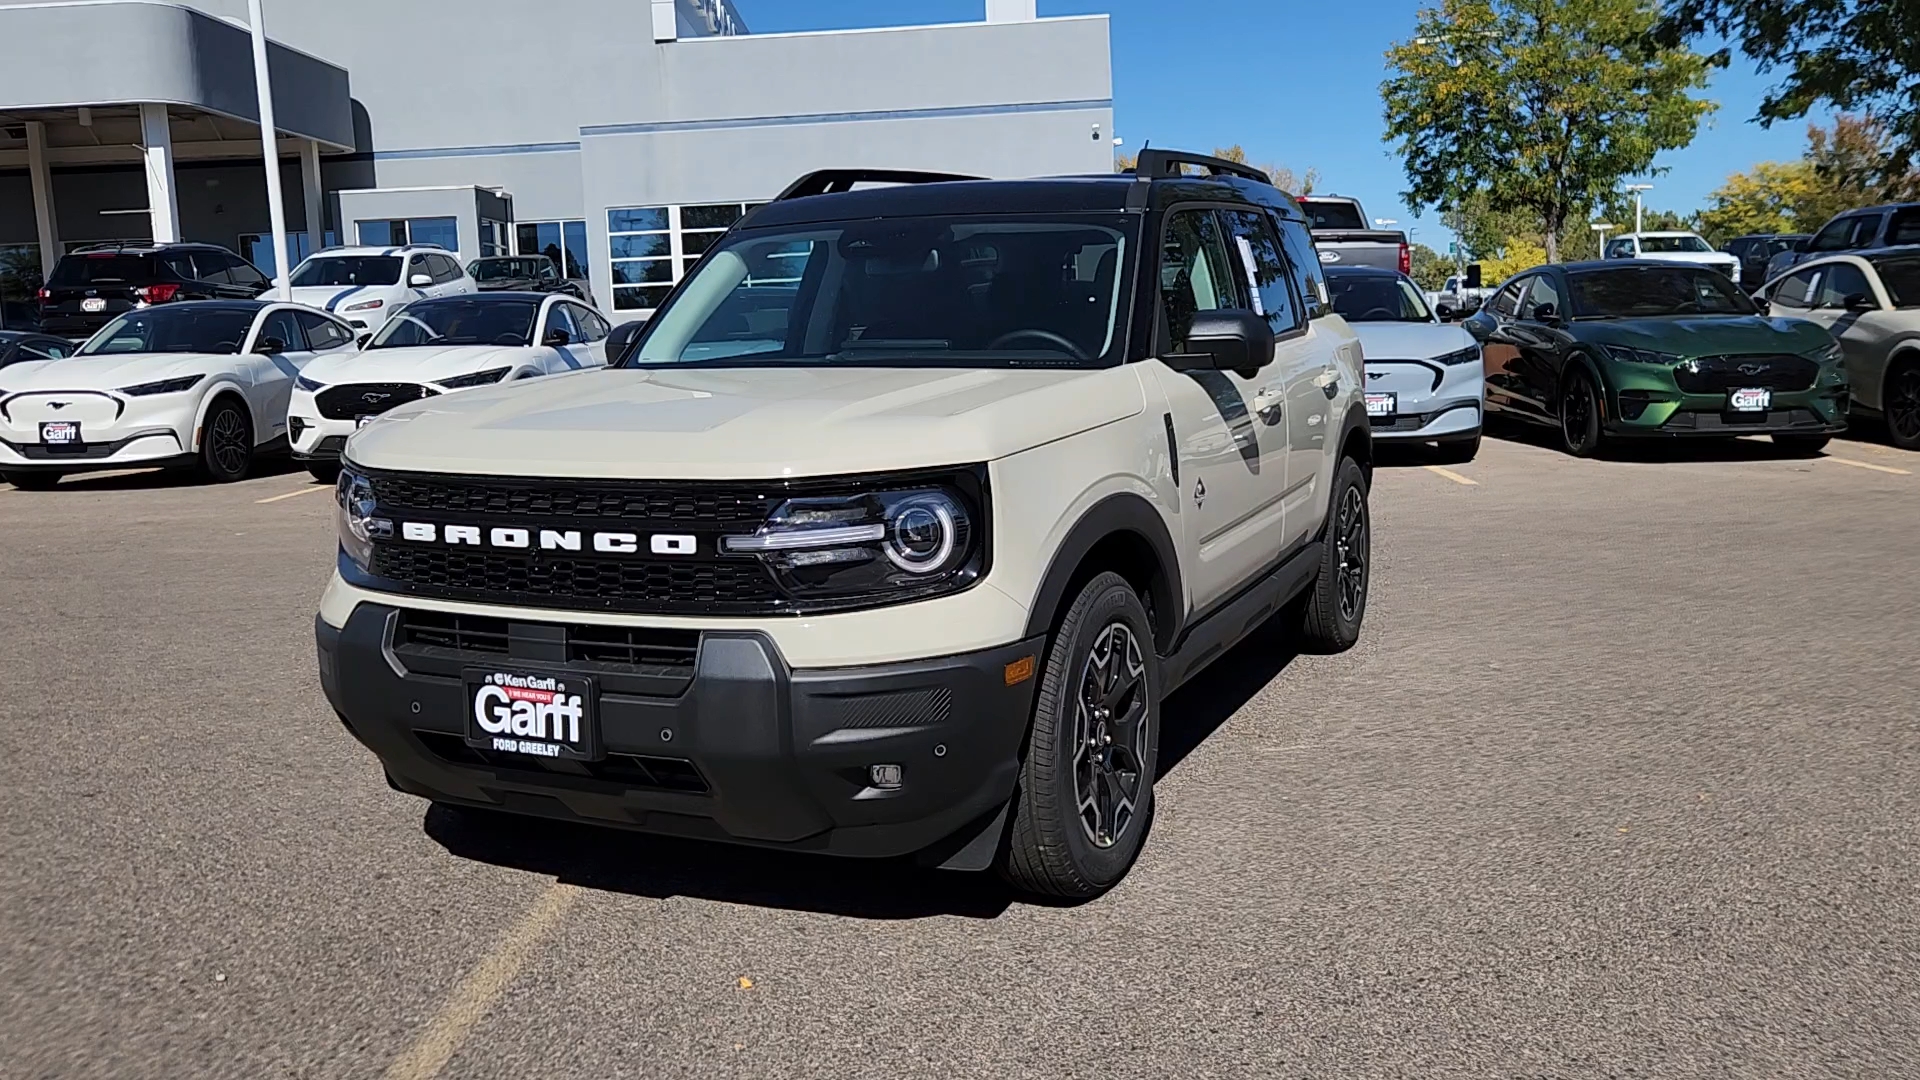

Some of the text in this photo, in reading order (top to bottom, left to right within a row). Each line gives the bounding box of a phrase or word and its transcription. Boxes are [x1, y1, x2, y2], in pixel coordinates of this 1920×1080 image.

[1365, 397, 1395, 412] arff
[1731, 391, 1770, 408] Garff
[42, 426, 76, 440] Garff
[402, 521, 697, 555] BRONCO
[503, 673, 556, 691] Ken Garff
[521, 691, 536, 700] HEAR
[536, 693, 547, 701] YOU
[475, 685, 583, 743] Garff
[493, 738, 560, 757] FORD GREELEY
